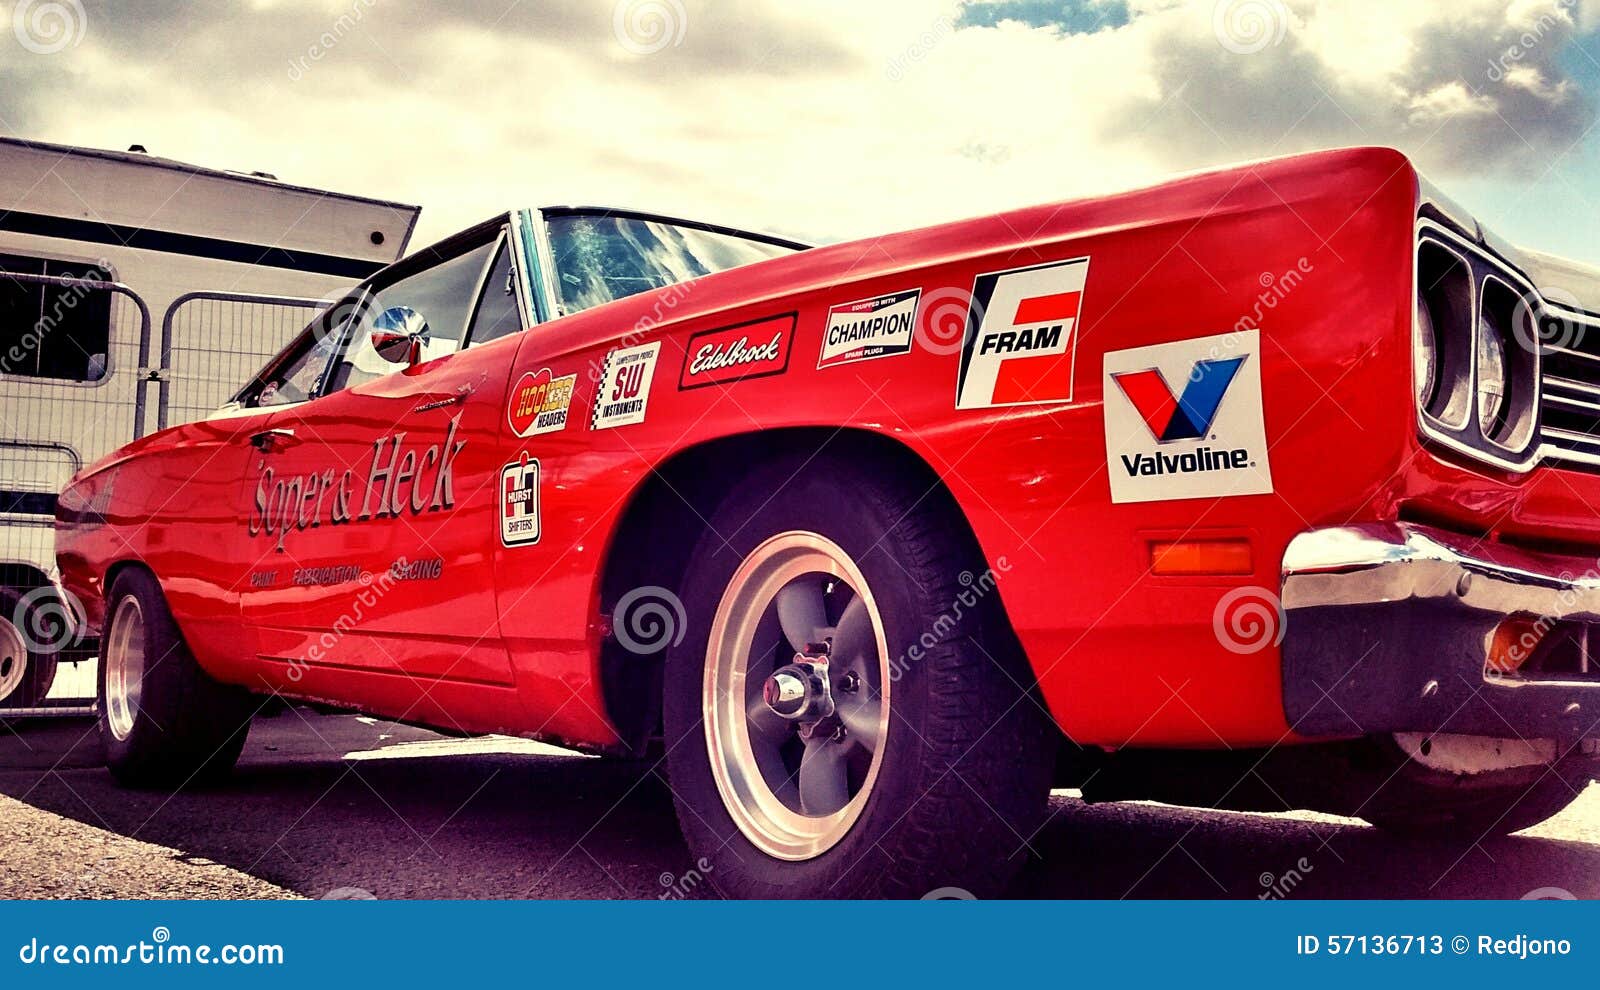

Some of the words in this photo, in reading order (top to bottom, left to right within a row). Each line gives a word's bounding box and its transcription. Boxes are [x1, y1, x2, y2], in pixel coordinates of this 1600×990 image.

[851, 299, 879, 312] EQUIPPED
[880, 297, 896, 306] WITH
[828, 312, 912, 346] CHAMPION
[979, 325, 1063, 355] FRAM
[689, 332, 782, 375] Edelbrock
[844, 348, 863, 359] SPARK
[863, 347, 884, 356] PLUGS
[612, 362, 646, 401] SW
[516, 377, 574, 418] HOOKER
[602, 399, 644, 418] INSTRUMENTS
[536, 410, 567, 428] HEADERS
[356, 408, 467, 521] Heck
[1120, 447, 1249, 477] Valvoline
[508, 488, 532, 504] HURST
[508, 519, 533, 533] SHIFTERS
[250, 569, 279, 588] PAINT
[291, 564, 361, 587] FABRICATION
[390, 558, 443, 582] RACING
